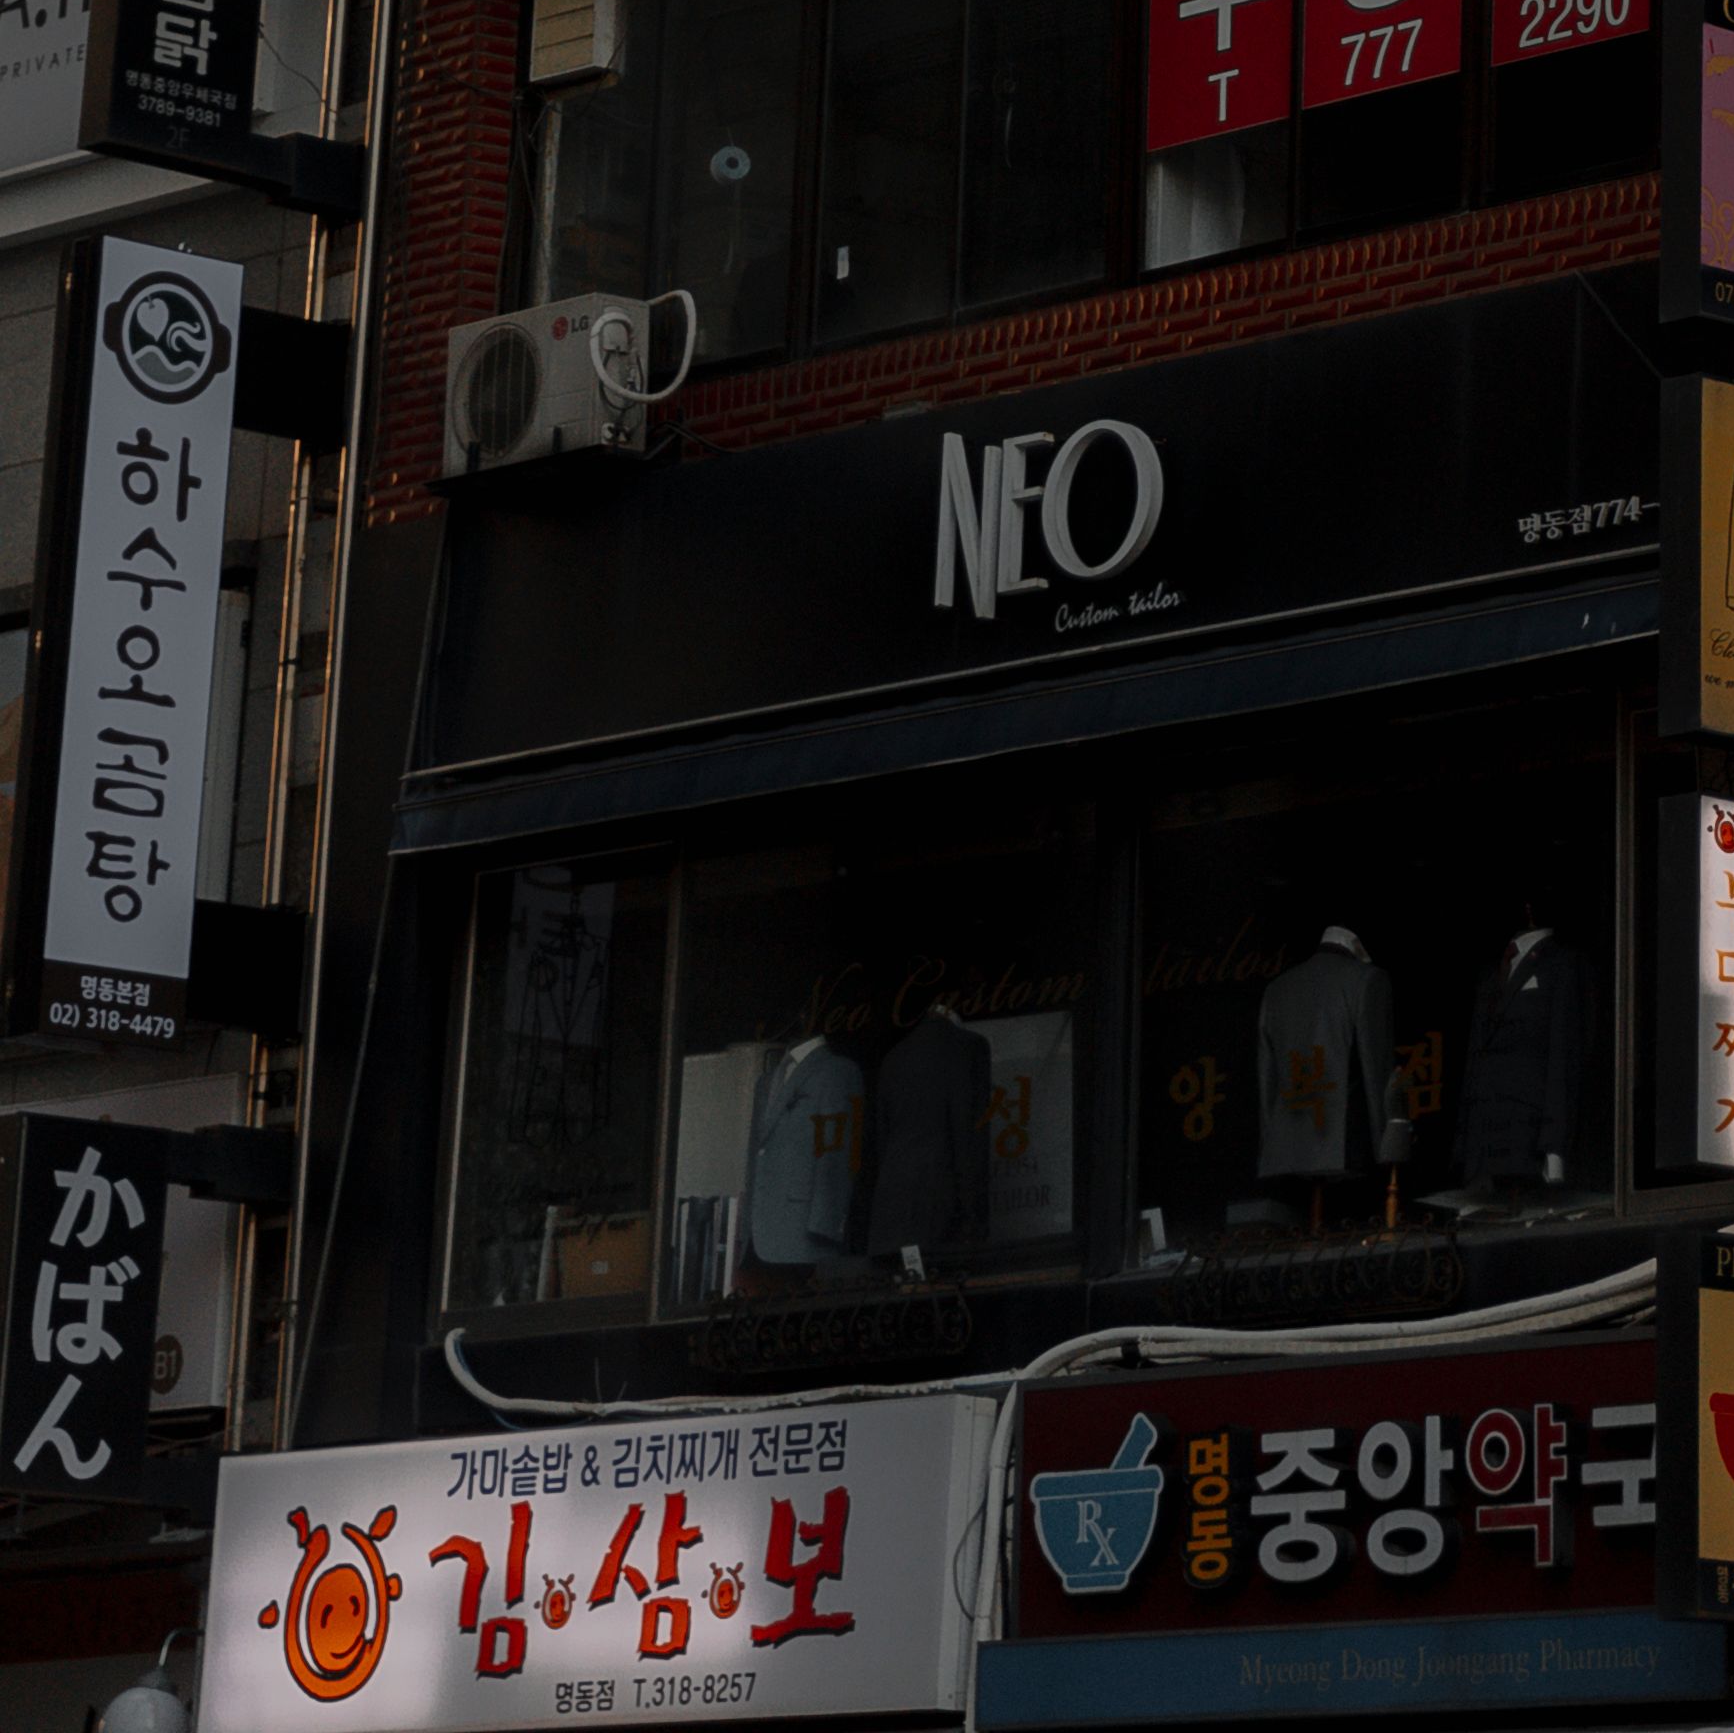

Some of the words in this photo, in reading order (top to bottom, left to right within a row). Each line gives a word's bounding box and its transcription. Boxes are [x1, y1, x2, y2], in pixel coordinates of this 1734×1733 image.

[1208, 68, 1239, 122] T
[1340, 18, 1424, 87] 777
[137, 94, 222, 128] 3789-9381
[934, 419, 1166, 620] NEO
[1054, 601, 1120, 633] Custom
[1127, 582, 1182, 617] tailor
[86, 427, 202, 922] 하수오곰탕
[49, 1002, 81, 1027] 02)
[86, 1005, 176, 1038] 318-4479
[79, 976, 151, 1007] 명동본점
[14, 1145, 146, 1480] かばん
[447, 1449, 573, 1501] 가마솥밥
[611, 1436, 739, 1490] 김치찌개
[748, 1419, 848, 1477] 전문점
[1186, 1432, 1230, 1583] 명동
[555, 1679, 616, 1715] 명동점
[634, 1672, 757, 1710] T.318-8257
[1239, 1650, 1332, 1689] Myeong
[1340, 1647, 1405, 1685] Dong
[1412, 1641, 1530, 1684] Joongang
[1539, 1635, 1660, 1675] Pharmacy
